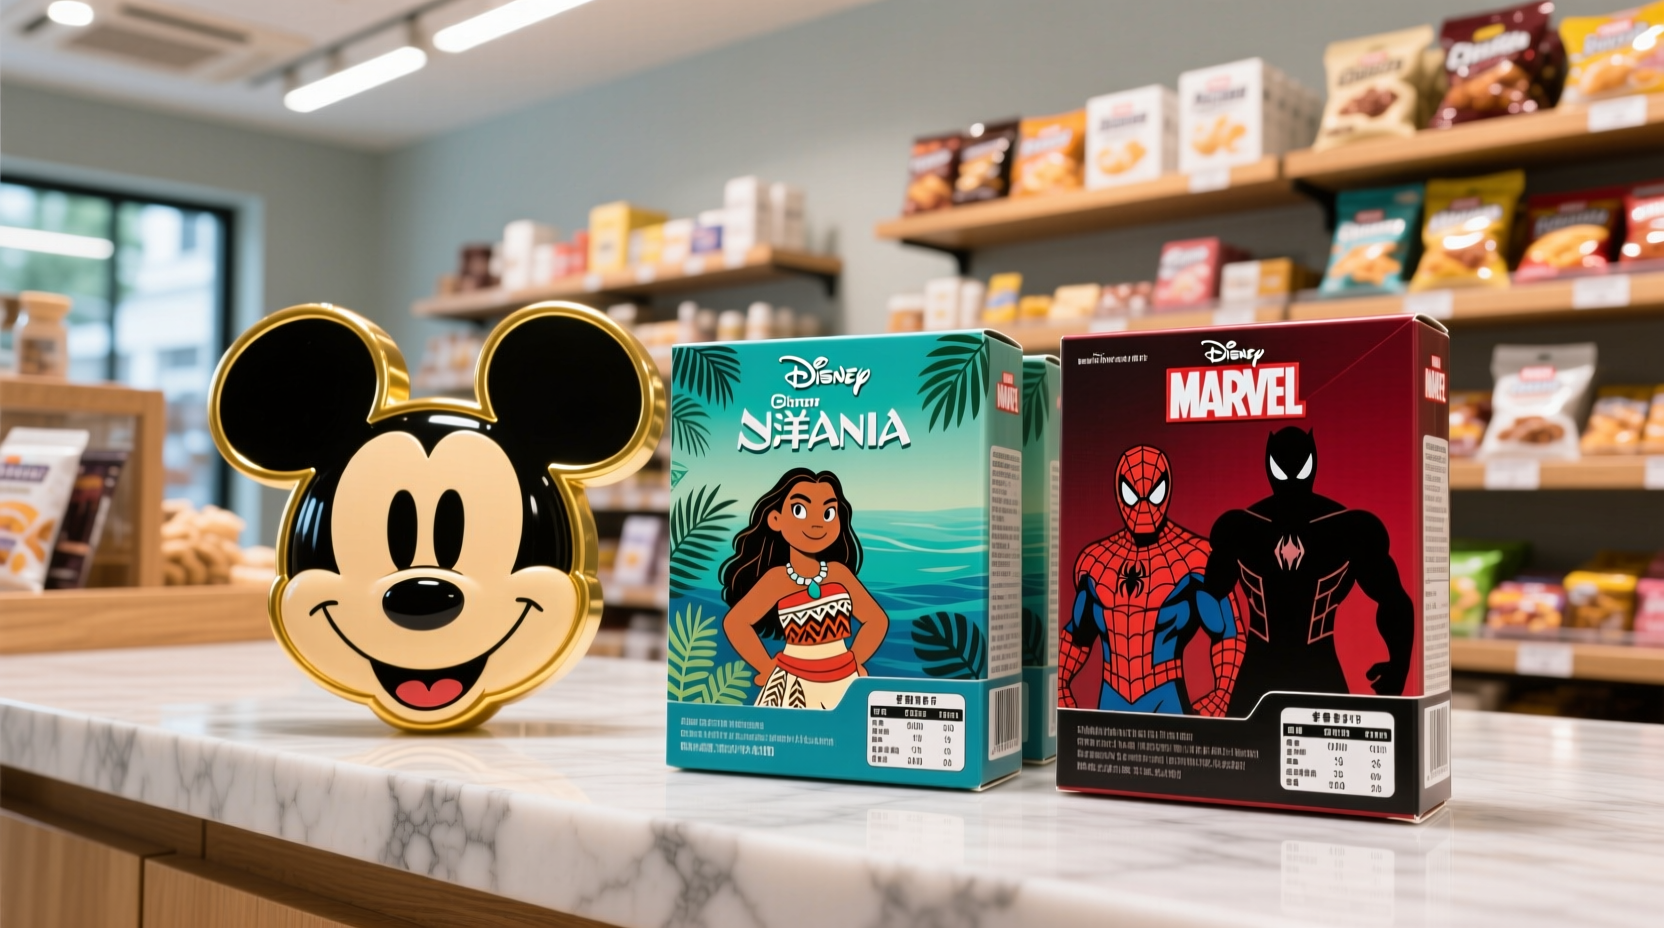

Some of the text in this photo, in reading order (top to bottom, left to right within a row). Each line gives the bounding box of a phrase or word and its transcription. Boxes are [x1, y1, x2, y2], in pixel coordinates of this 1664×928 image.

[1201, 340, 1265, 368] Disney
[778, 355, 871, 396] Disney
[1169, 366, 1303, 419] MARVEL
